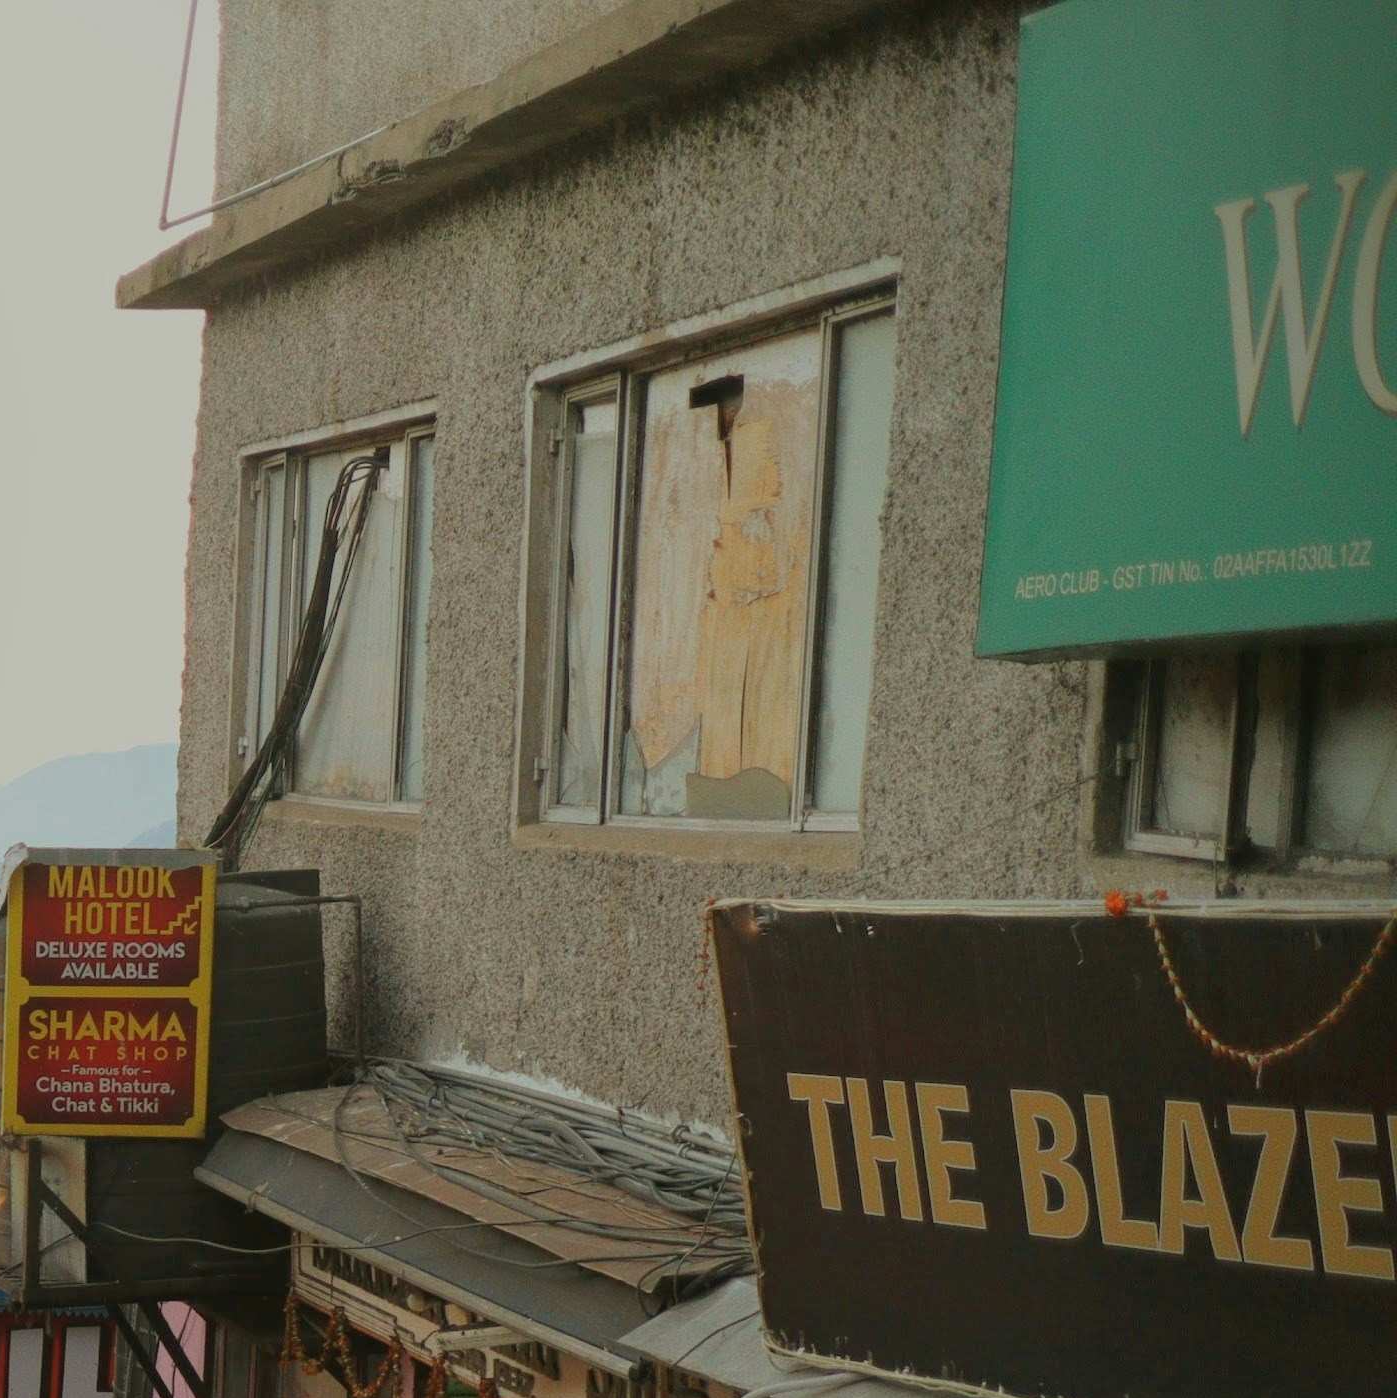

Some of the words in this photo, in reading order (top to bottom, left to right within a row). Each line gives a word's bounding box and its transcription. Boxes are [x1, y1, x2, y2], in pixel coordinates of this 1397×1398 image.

[1013, 575, 1056, 599] AERO
[1060, 569, 1100, 595] CLUB
[1113, 563, 1145, 591] GST
[1149, 561, 1175, 587] TIN
[48, 865, 176, 899] MALOOK
[64, 902, 159, 936] HOTEL
[35, 941, 108, 959] DELUXE
[112, 942, 186, 959] ROOMS
[60, 962, 160, 980] AVAILABLE
[28, 1009, 187, 1042] SHARMA
[27, 1045, 97, 1061] CHAT
[116, 1045, 188, 1061] SHOP
[71, 1064, 119, 1076] Famous
[122, 1064, 140, 1076] for
[35, 1076, 94, 1094] Chana
[98, 1077, 176, 1096] Bhatura,
[51, 1096, 96, 1114] Chat
[99, 1097, 113, 1113] &
[116, 1096, 159, 1114] Tikki
[786, 1071, 987, 1230] THE
